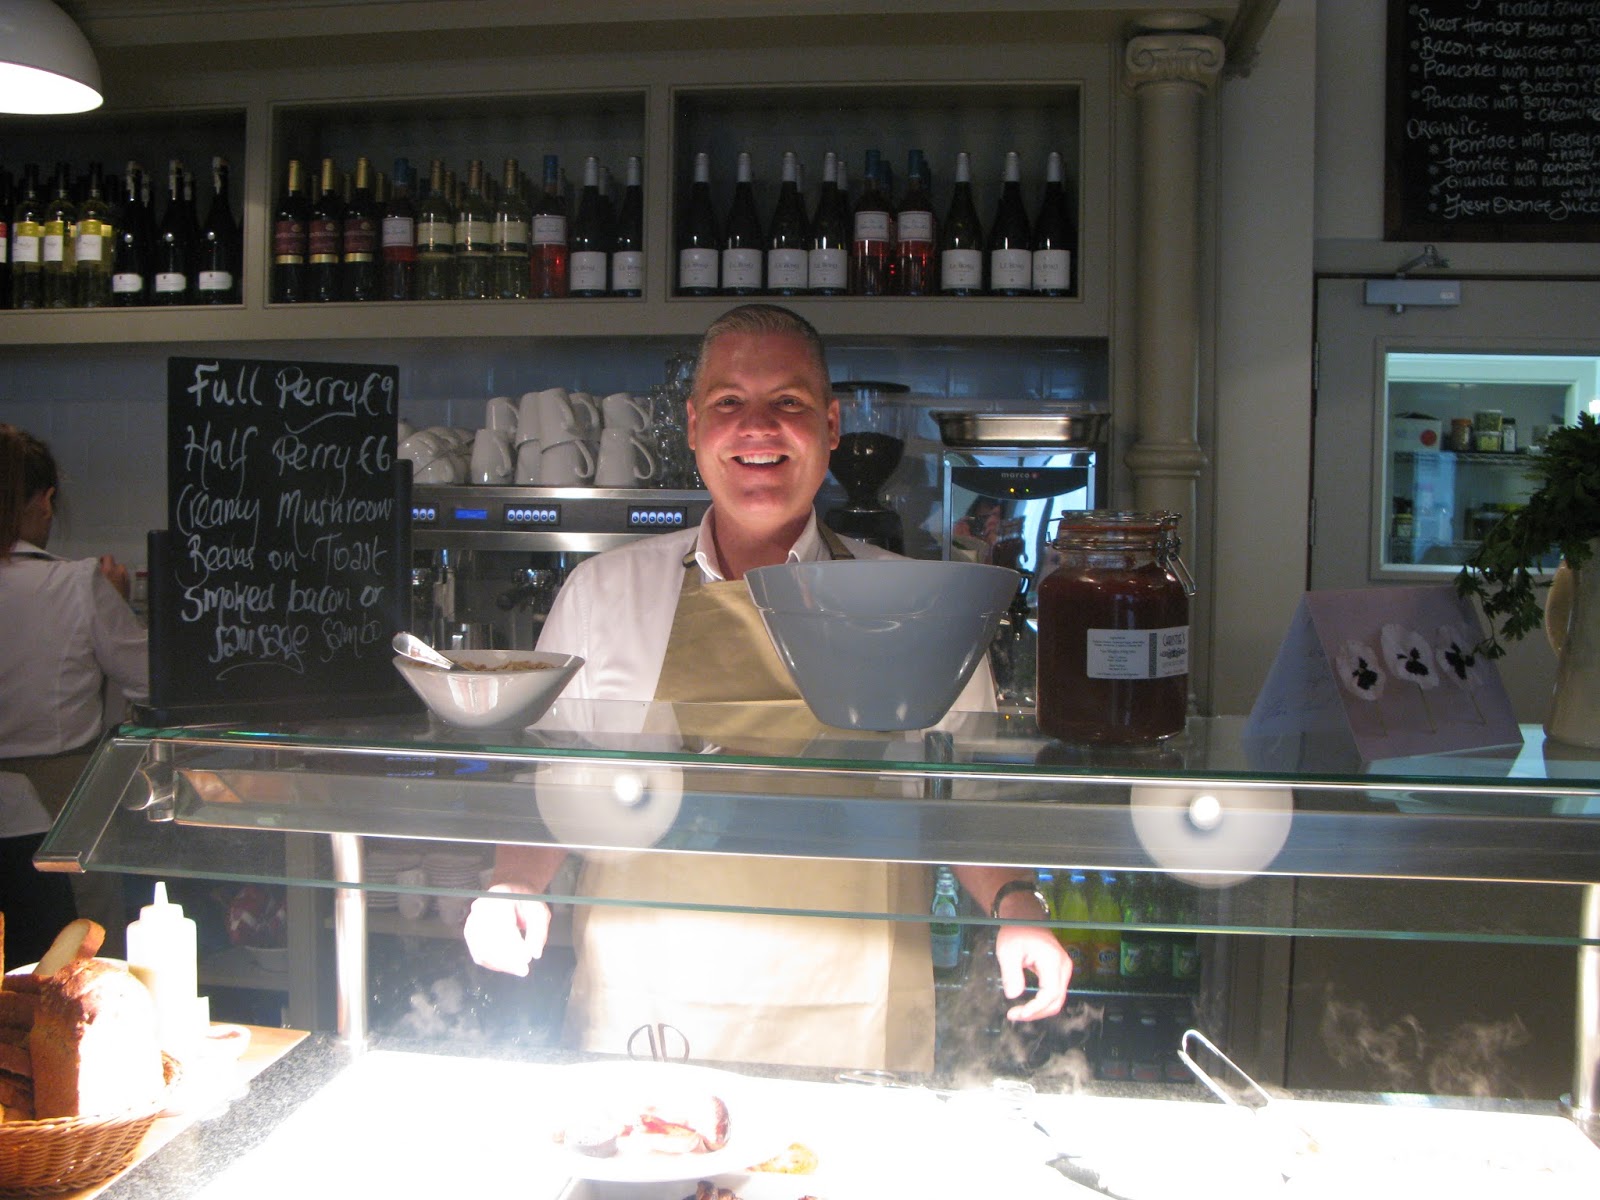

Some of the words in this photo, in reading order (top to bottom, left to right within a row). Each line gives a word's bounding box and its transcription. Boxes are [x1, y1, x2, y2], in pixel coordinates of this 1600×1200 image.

[1419, 36, 1475, 60] Bacon
[1423, 60, 1497, 79] Pancakes
[1421, 85, 1490, 111] Pancakes
[187, 361, 262, 407] Full
[275, 366, 356, 421] Perry
[184, 421, 258, 498] Half
[272, 435, 348, 499] Perry
[176, 484, 261, 546] Creamy
[277, 489, 394, 548] Mushroom
[269, 551, 299, 572] on
[312, 533, 387, 578] Toast
[181, 581, 275, 624] Smoked
[288, 580, 351, 616] bacon
[360, 585, 386, 607] or
